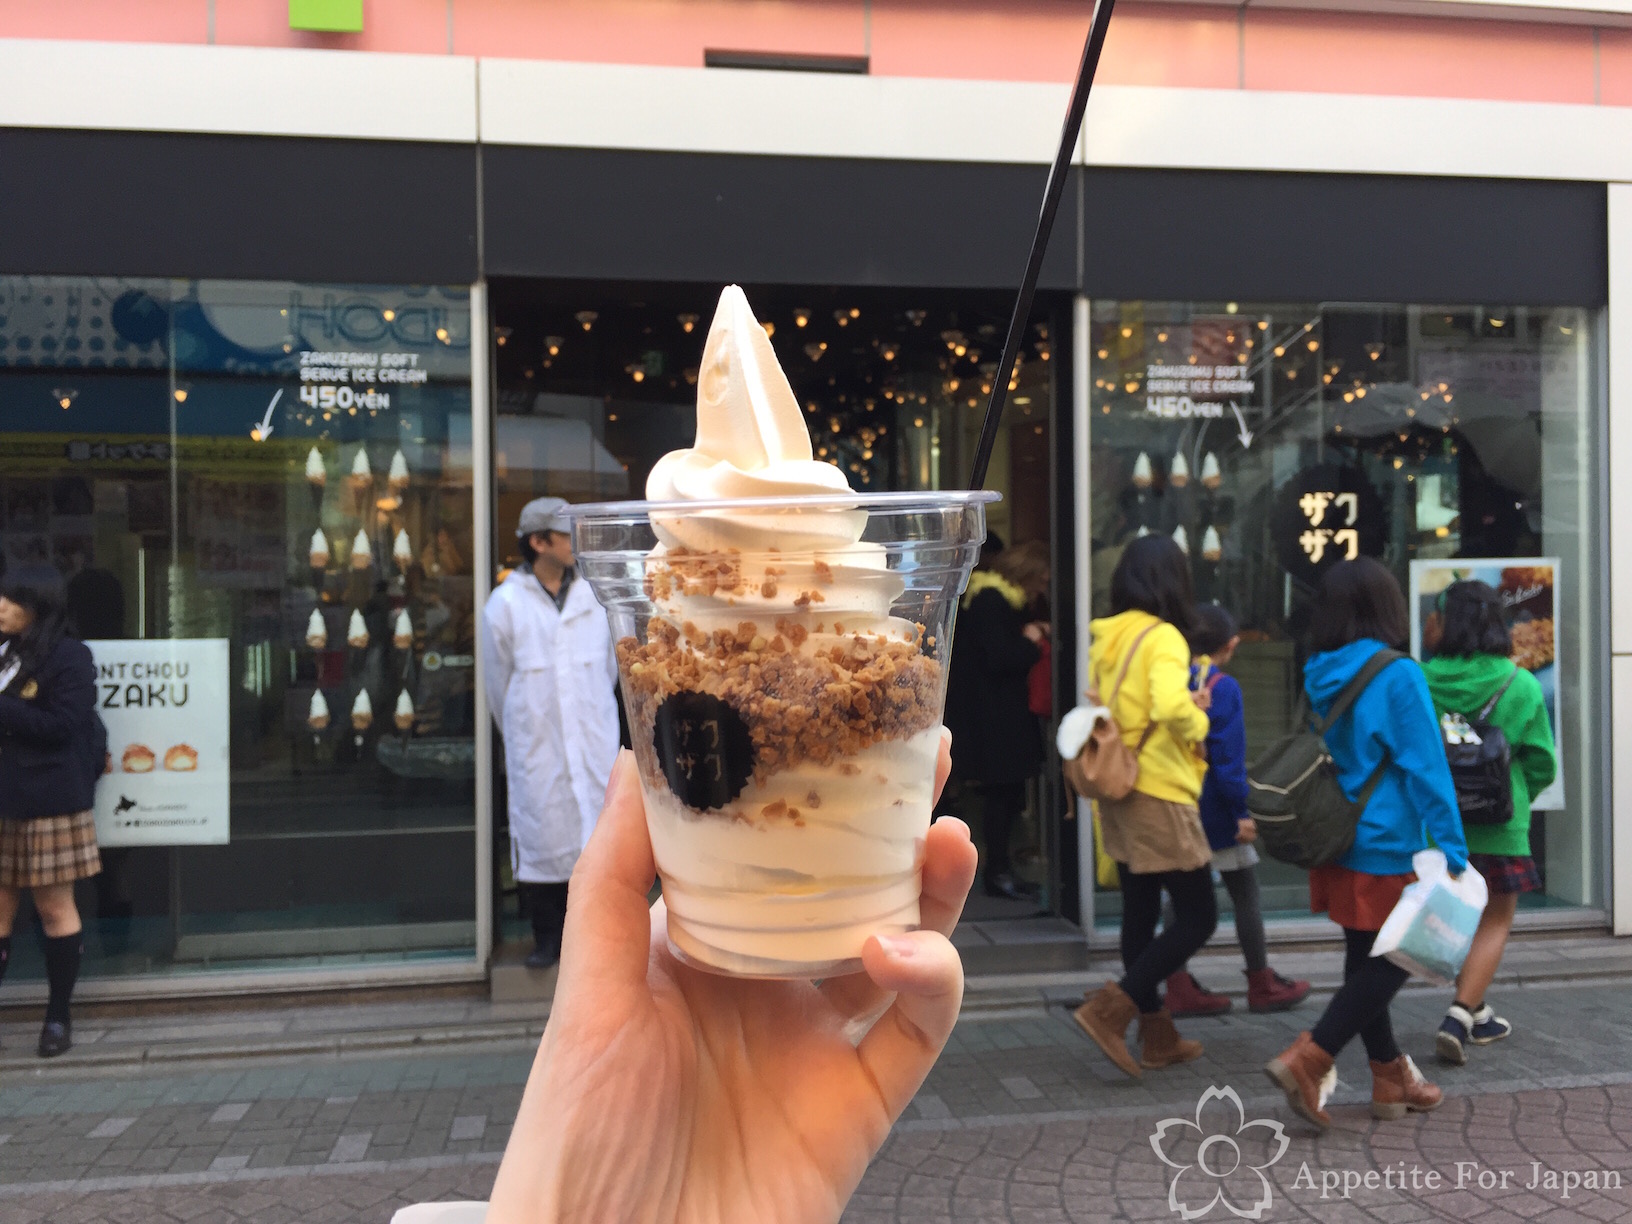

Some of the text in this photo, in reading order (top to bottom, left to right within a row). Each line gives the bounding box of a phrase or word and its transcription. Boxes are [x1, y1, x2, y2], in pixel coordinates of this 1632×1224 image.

[381, 353, 419, 367] SOFT
[352, 368, 376, 382] ICE
[378, 369, 427, 383] CREAM
[1299, 491, 1358, 527] ザク
[1299, 528, 1358, 564] ザク
